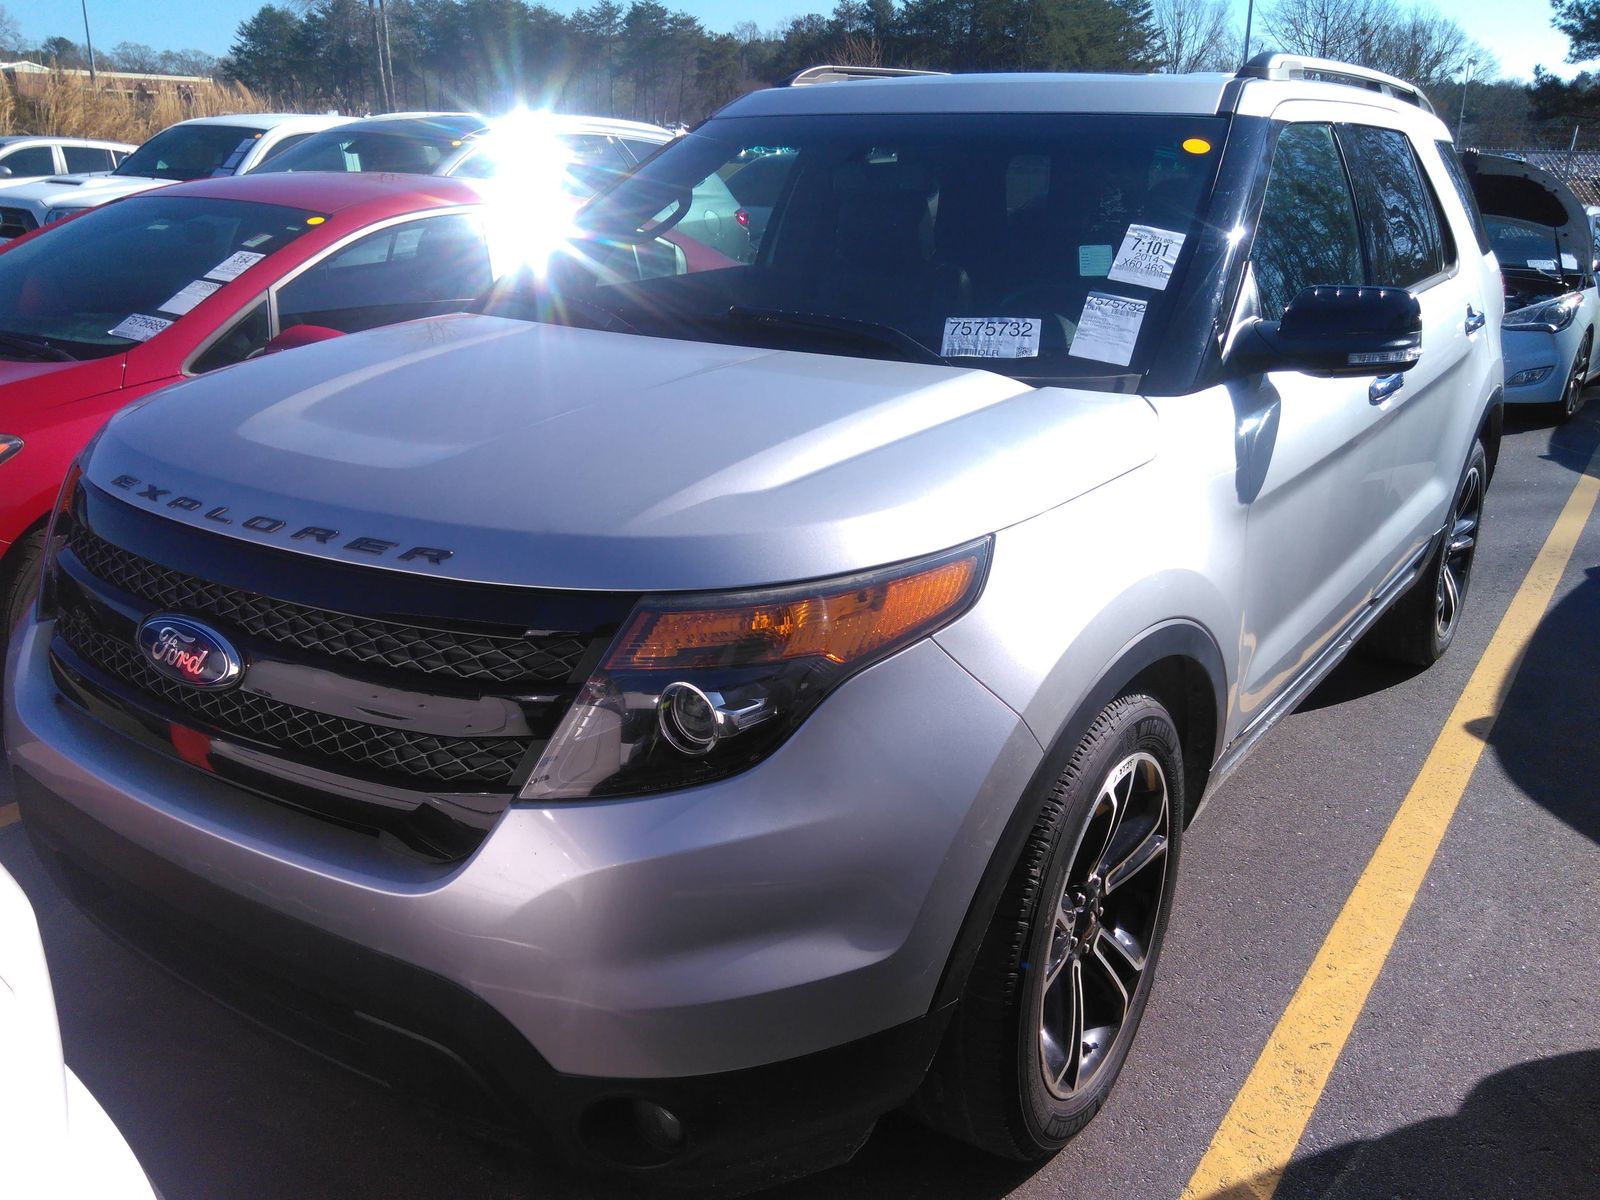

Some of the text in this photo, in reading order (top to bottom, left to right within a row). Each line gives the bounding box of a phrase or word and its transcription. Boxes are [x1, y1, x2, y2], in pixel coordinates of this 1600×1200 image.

[1131, 237, 1170, 257] 7:101
[1133, 252, 1160, 264] 2014
[1087, 296, 1146, 313] 7575732
[950, 321, 1033, 337] 7575732
[978, 349, 1000, 357] DLR
[110, 474, 455, 566] EXPLORER
[151, 626, 209, 675] Ford
